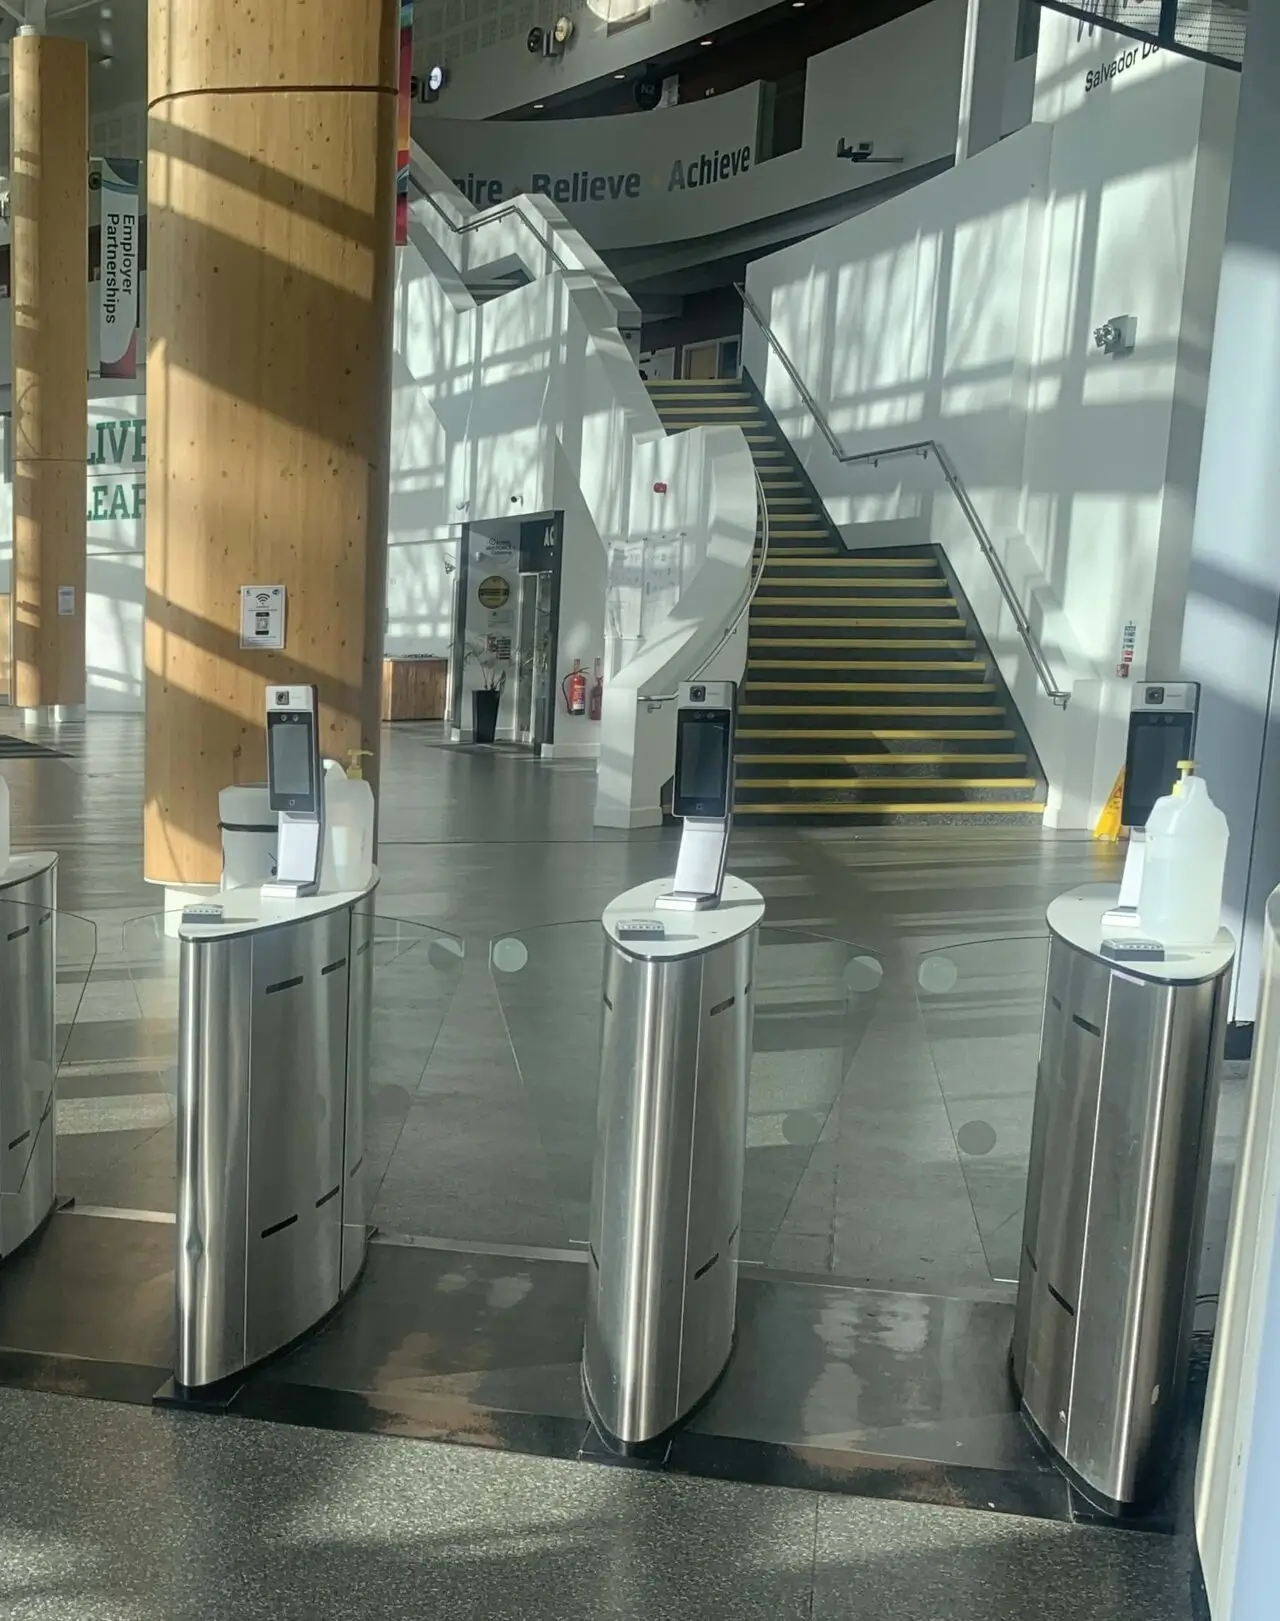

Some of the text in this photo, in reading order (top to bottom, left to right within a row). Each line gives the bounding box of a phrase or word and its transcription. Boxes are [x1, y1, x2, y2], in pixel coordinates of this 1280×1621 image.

[1084, 47, 1138, 92] Salvador
[531, 171, 641, 203] Believe
[668, 145, 751, 192] Achieve
[104, 213, 120, 324] Partnerships
[120, 214, 135, 296] Employer
